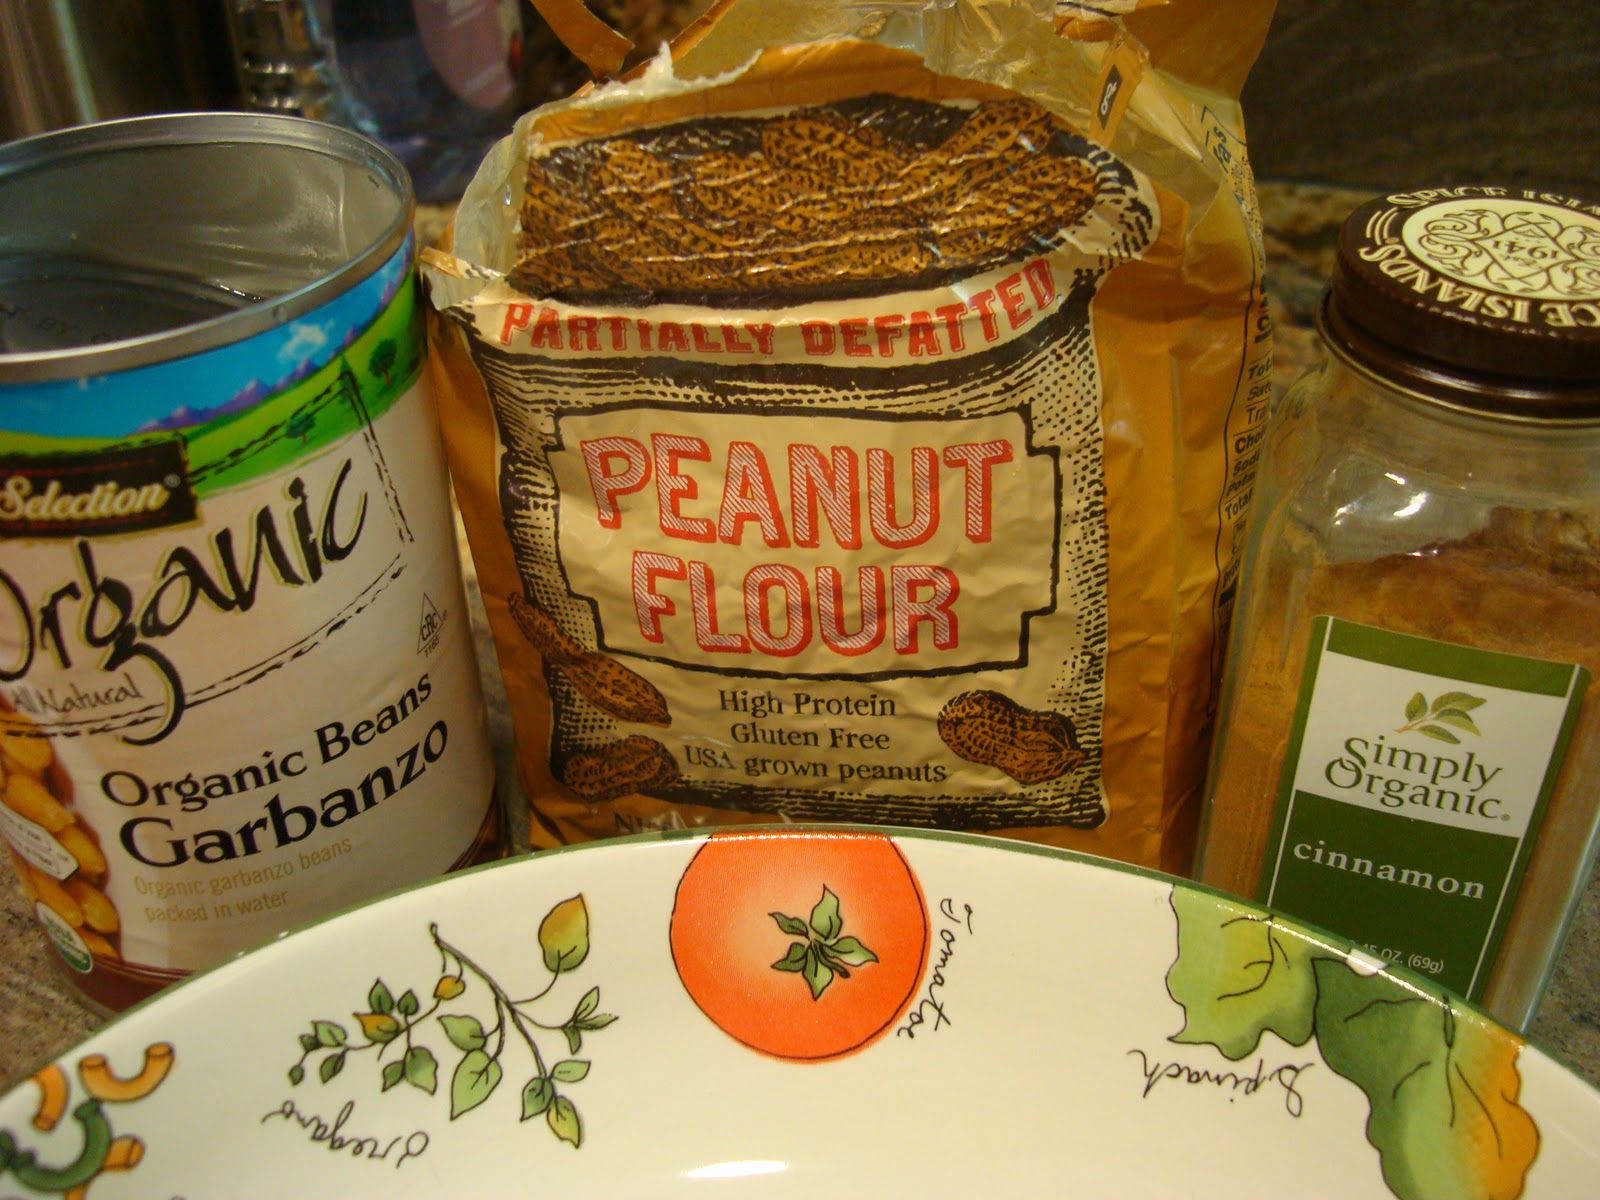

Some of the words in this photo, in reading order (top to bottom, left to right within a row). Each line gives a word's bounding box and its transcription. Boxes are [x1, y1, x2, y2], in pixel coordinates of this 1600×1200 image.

[1386, 186, 1507, 209] SPICE
[1492, 241, 1558, 259] 1941
[499, 302, 775, 354] PARTIALLY
[801, 259, 1055, 357] DEFATTED
[1359, 245, 1530, 324] ISLANDS
[0, 475, 171, 519] Selection
[581, 432, 1014, 550] PEANUT
[631, 551, 961, 657] FLOUR
[37, 672, 144, 713] Natural
[718, 689, 783, 718] High
[794, 692, 896, 717] Protein
[101, 750, 307, 812] Organic
[315, 673, 432, 765] Beans
[683, 744, 736, 769] USA
[743, 757, 828, 777] grown
[839, 761, 947, 783] peanuts
[730, 722, 820, 747] Gluten
[829, 728, 890, 750] Free
[1344, 735, 1503, 791] Simply
[120, 720, 448, 868] Garbanzo
[1325, 756, 1502, 819] Organic
[133, 876, 204, 899] Organic
[209, 860, 294, 896] garbanzo
[299, 838, 352, 870] beans
[1293, 840, 1484, 899] cinnamon
[145, 907, 208, 924] packed
[214, 905, 232, 918] in
[236, 890, 288, 913] water
[1408, 953, 1445, 974] (69g)
[1126, 1049, 1315, 1117] Spinach
